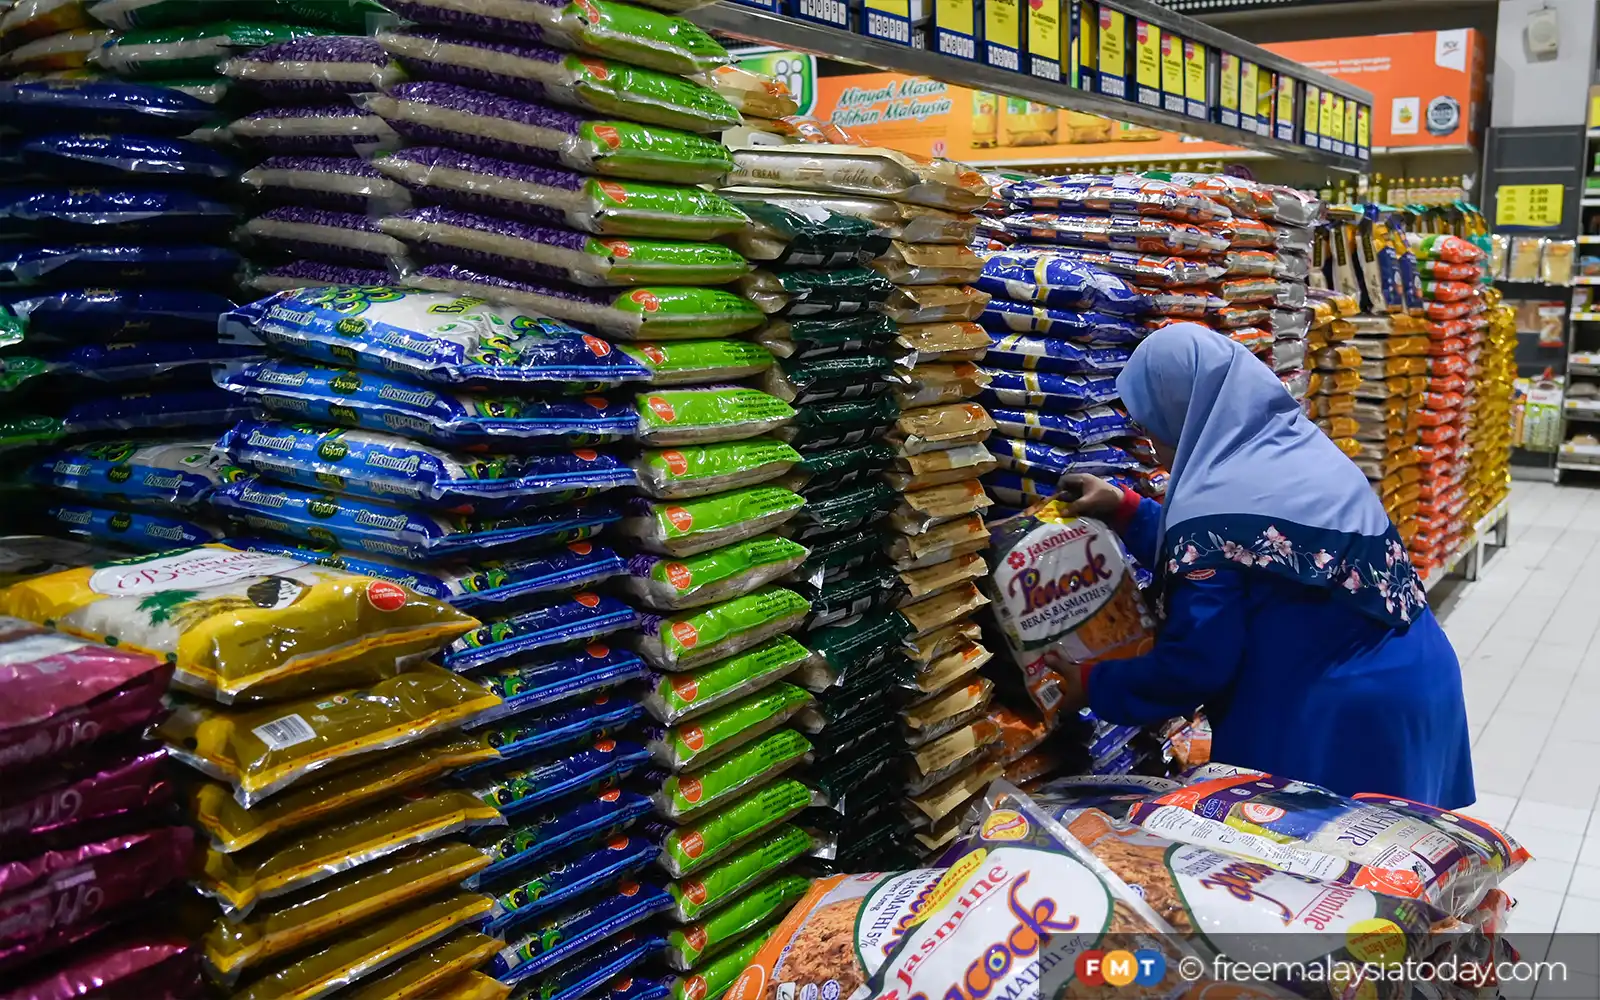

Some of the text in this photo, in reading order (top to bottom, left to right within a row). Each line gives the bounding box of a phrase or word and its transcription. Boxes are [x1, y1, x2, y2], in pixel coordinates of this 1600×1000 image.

[840, 79, 946, 107] Minyak Masak
[883, 98, 952, 121] Malaysia
[751, 168, 781, 180] CREAM
[379, 384, 436, 408] Basmathi
[248, 430, 297, 451] Basmathi
[366, 450, 420, 473] Basmathi
[1026, 523, 1089, 563] Jasmine
[1009, 533, 1113, 617] Peacock
[1020, 609, 1053, 632] BERAS
[1051, 589, 1100, 618] BASMATHI
[896, 863, 1010, 992] Jasmine
[1061, 935, 1092, 956] 5%
